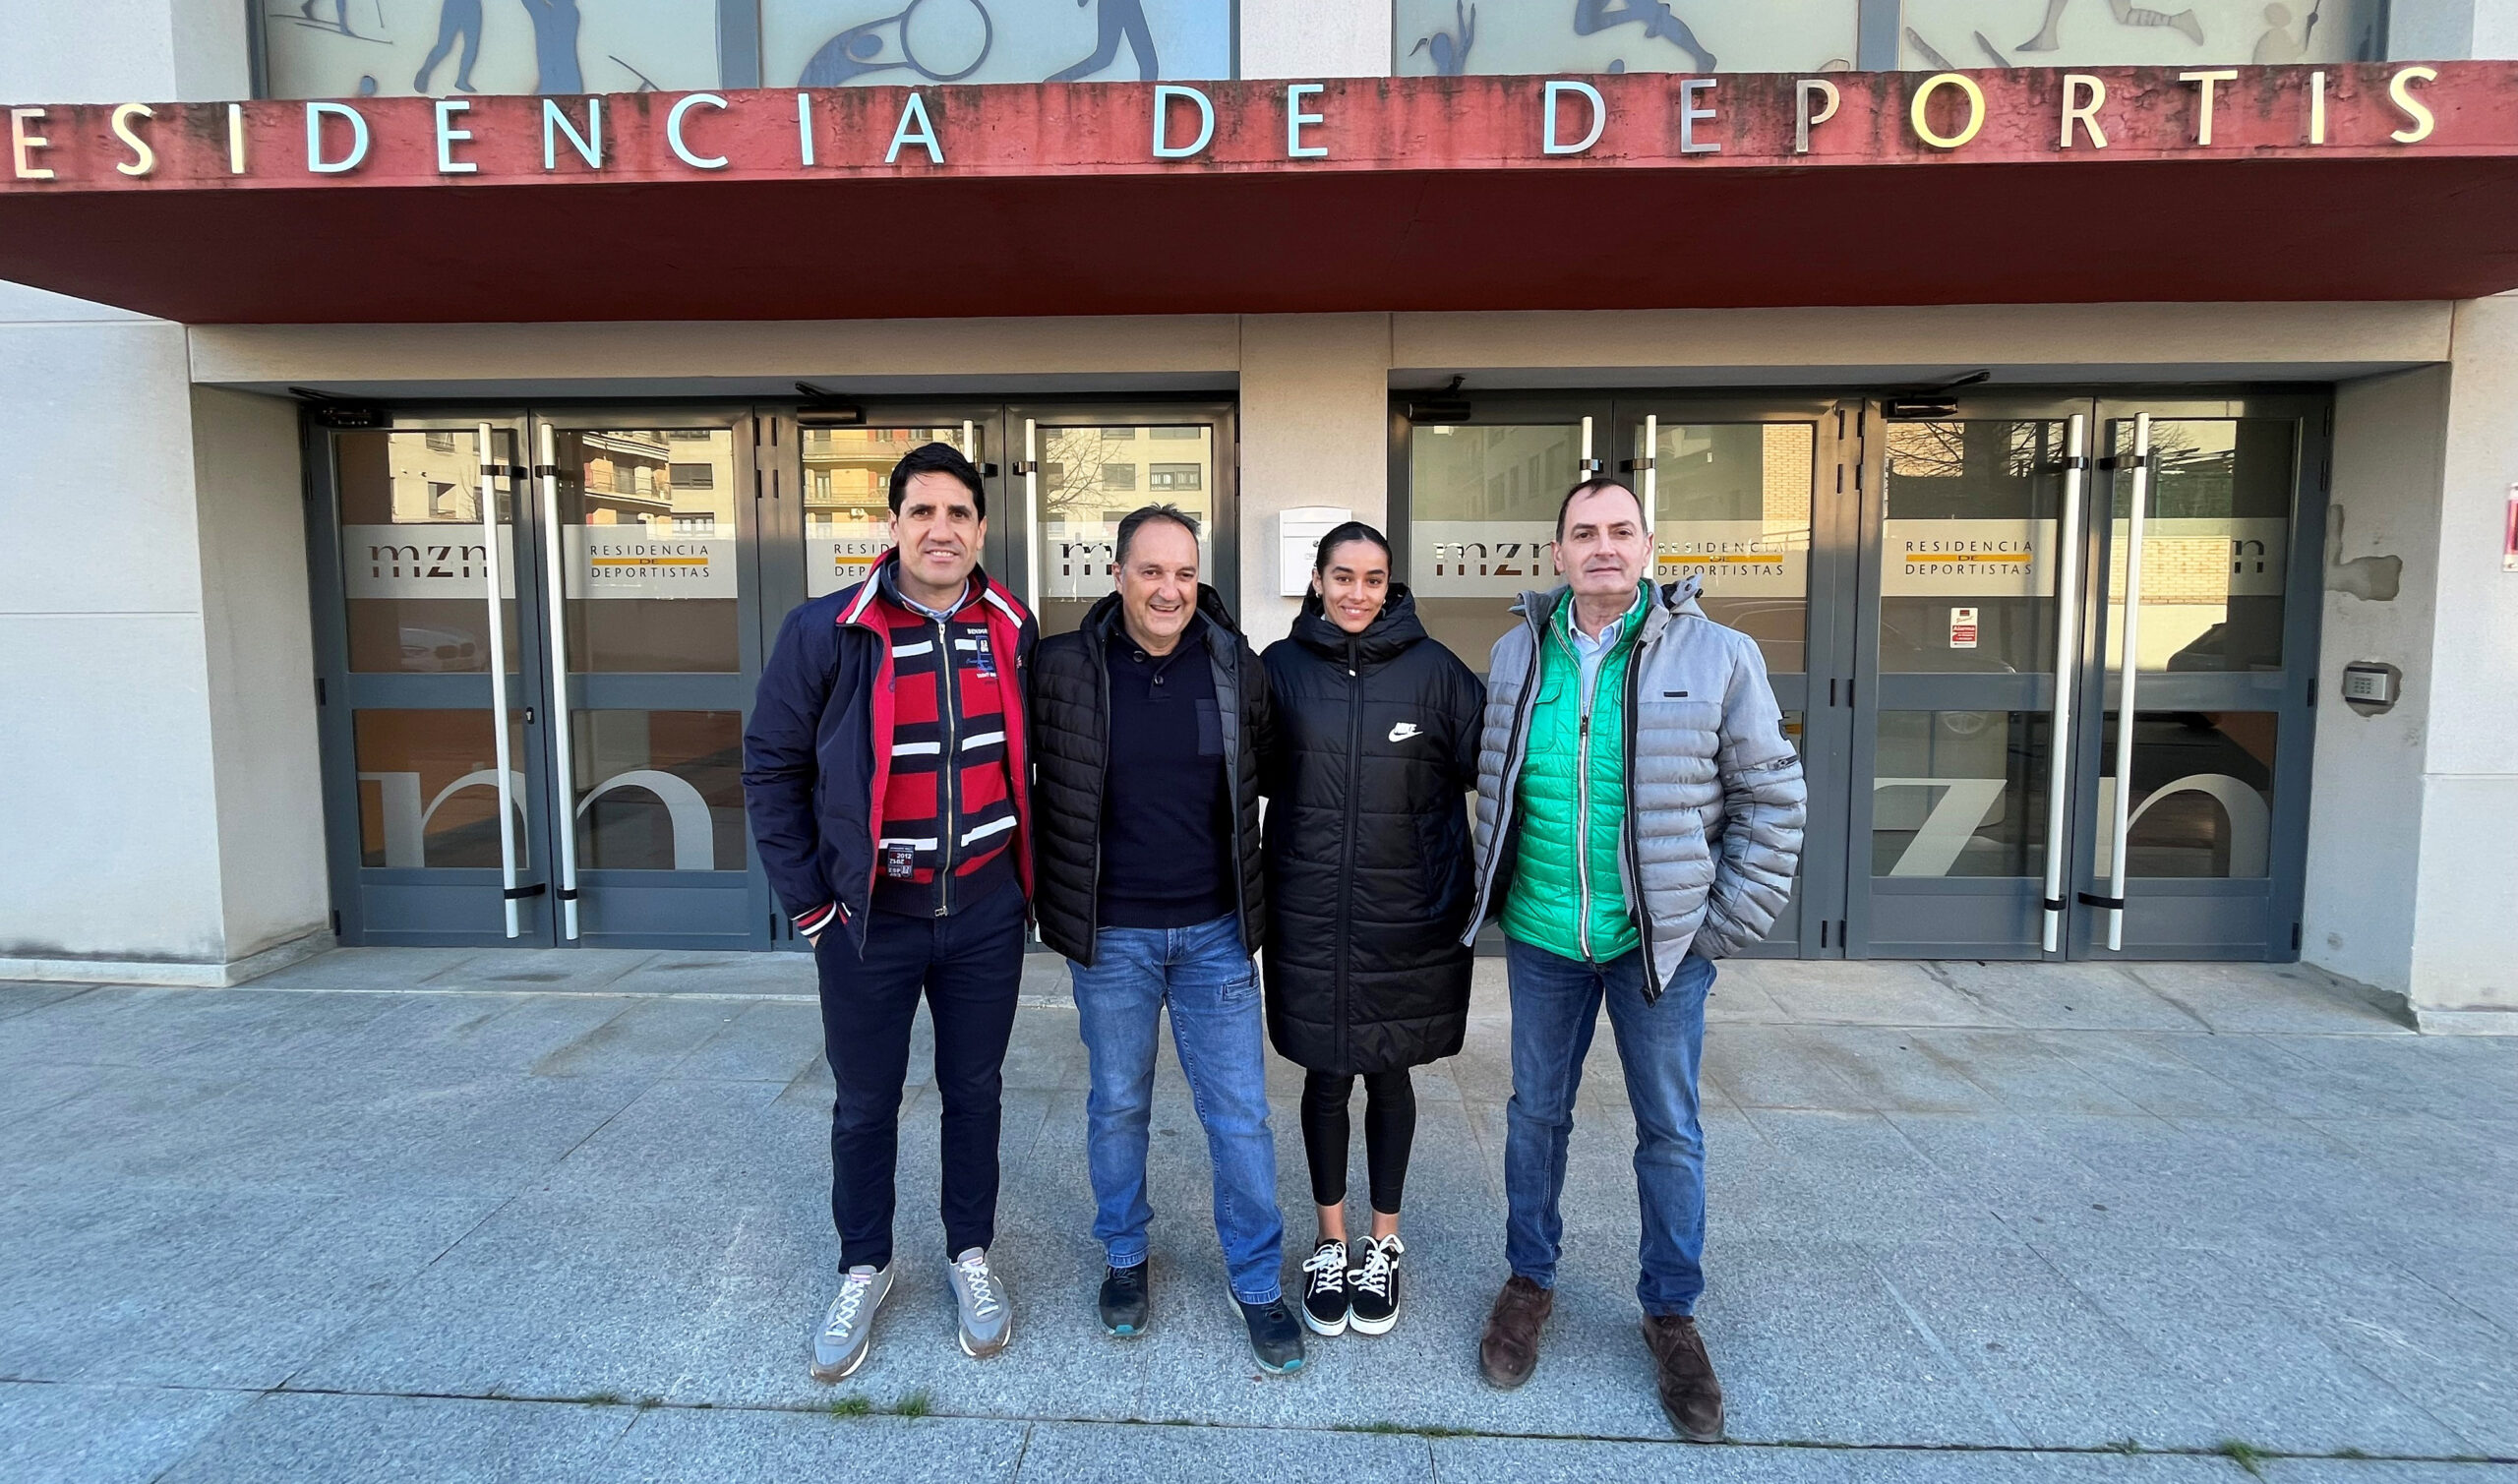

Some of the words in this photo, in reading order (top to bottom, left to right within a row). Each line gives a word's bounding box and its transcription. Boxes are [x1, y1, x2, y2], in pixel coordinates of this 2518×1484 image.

[1152, 84, 1330, 158] DE
[1542, 65, 2438, 155] DEPORTIS
[590, 545, 709, 556] RESIDENCIA
[1905, 541, 2033, 552] RESIDENCIA
[367, 545, 488, 578] mzn
[591, 566, 710, 578] DEPORTISTAS
[1657, 564, 1784, 576] DEPORTISTAS
[1905, 564, 2032, 575] DEPORTISTAS
